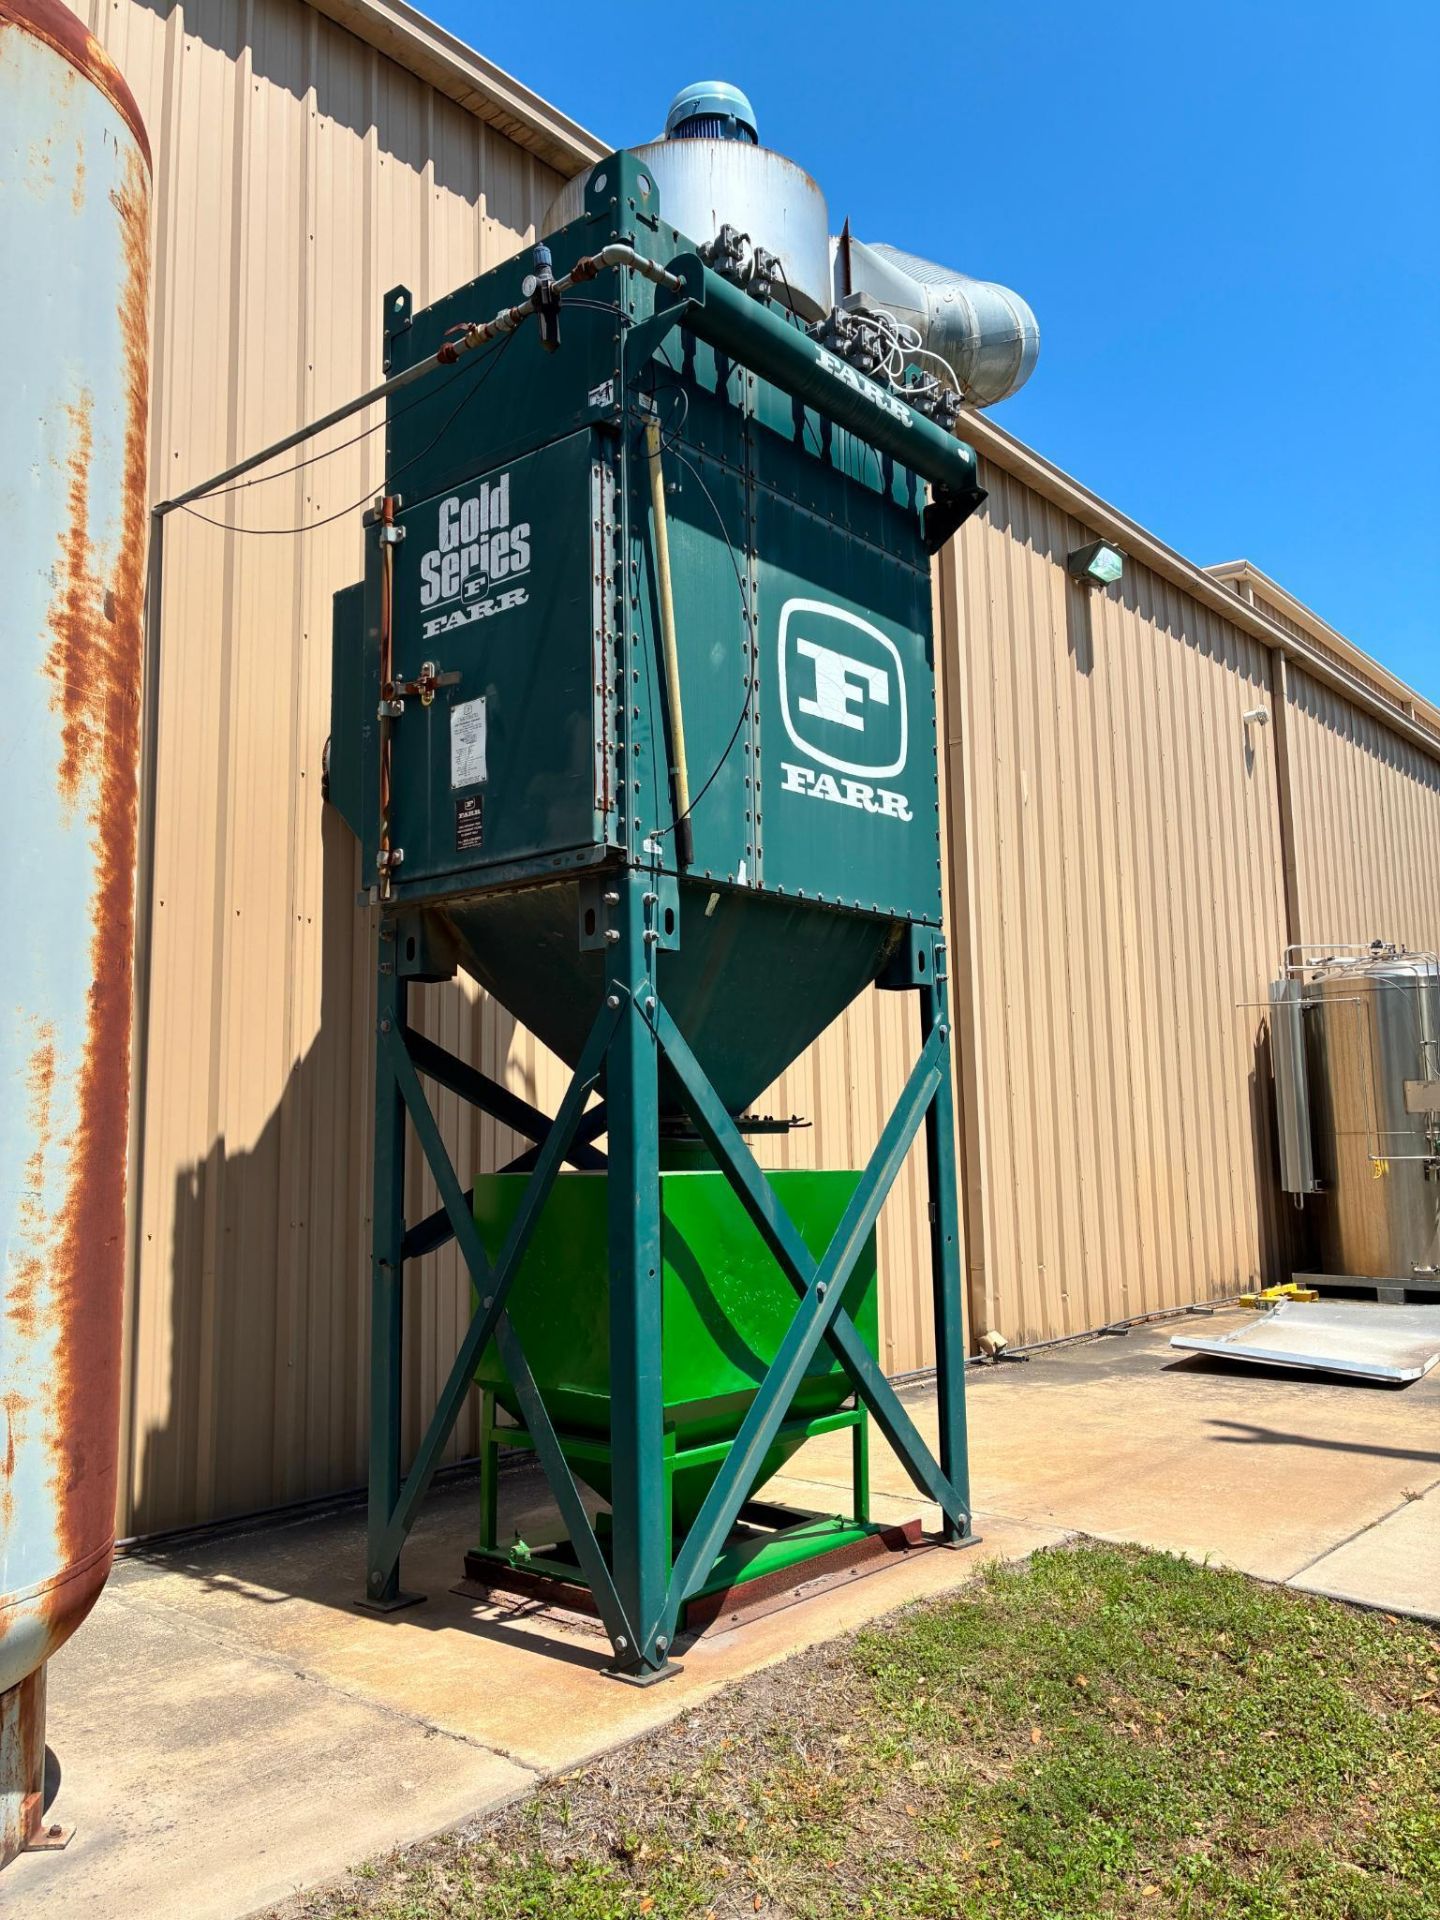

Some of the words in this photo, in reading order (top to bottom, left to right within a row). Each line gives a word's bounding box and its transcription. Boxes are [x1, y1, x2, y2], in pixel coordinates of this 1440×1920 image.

[814, 344, 914, 428] FARR
[438, 472, 510, 553] Gold
[420, 522, 531, 606] Series
[464, 576, 486, 598] F
[422, 587, 530, 640] FARR
[796, 637, 890, 733] F
[780, 761, 913, 822] FARR
